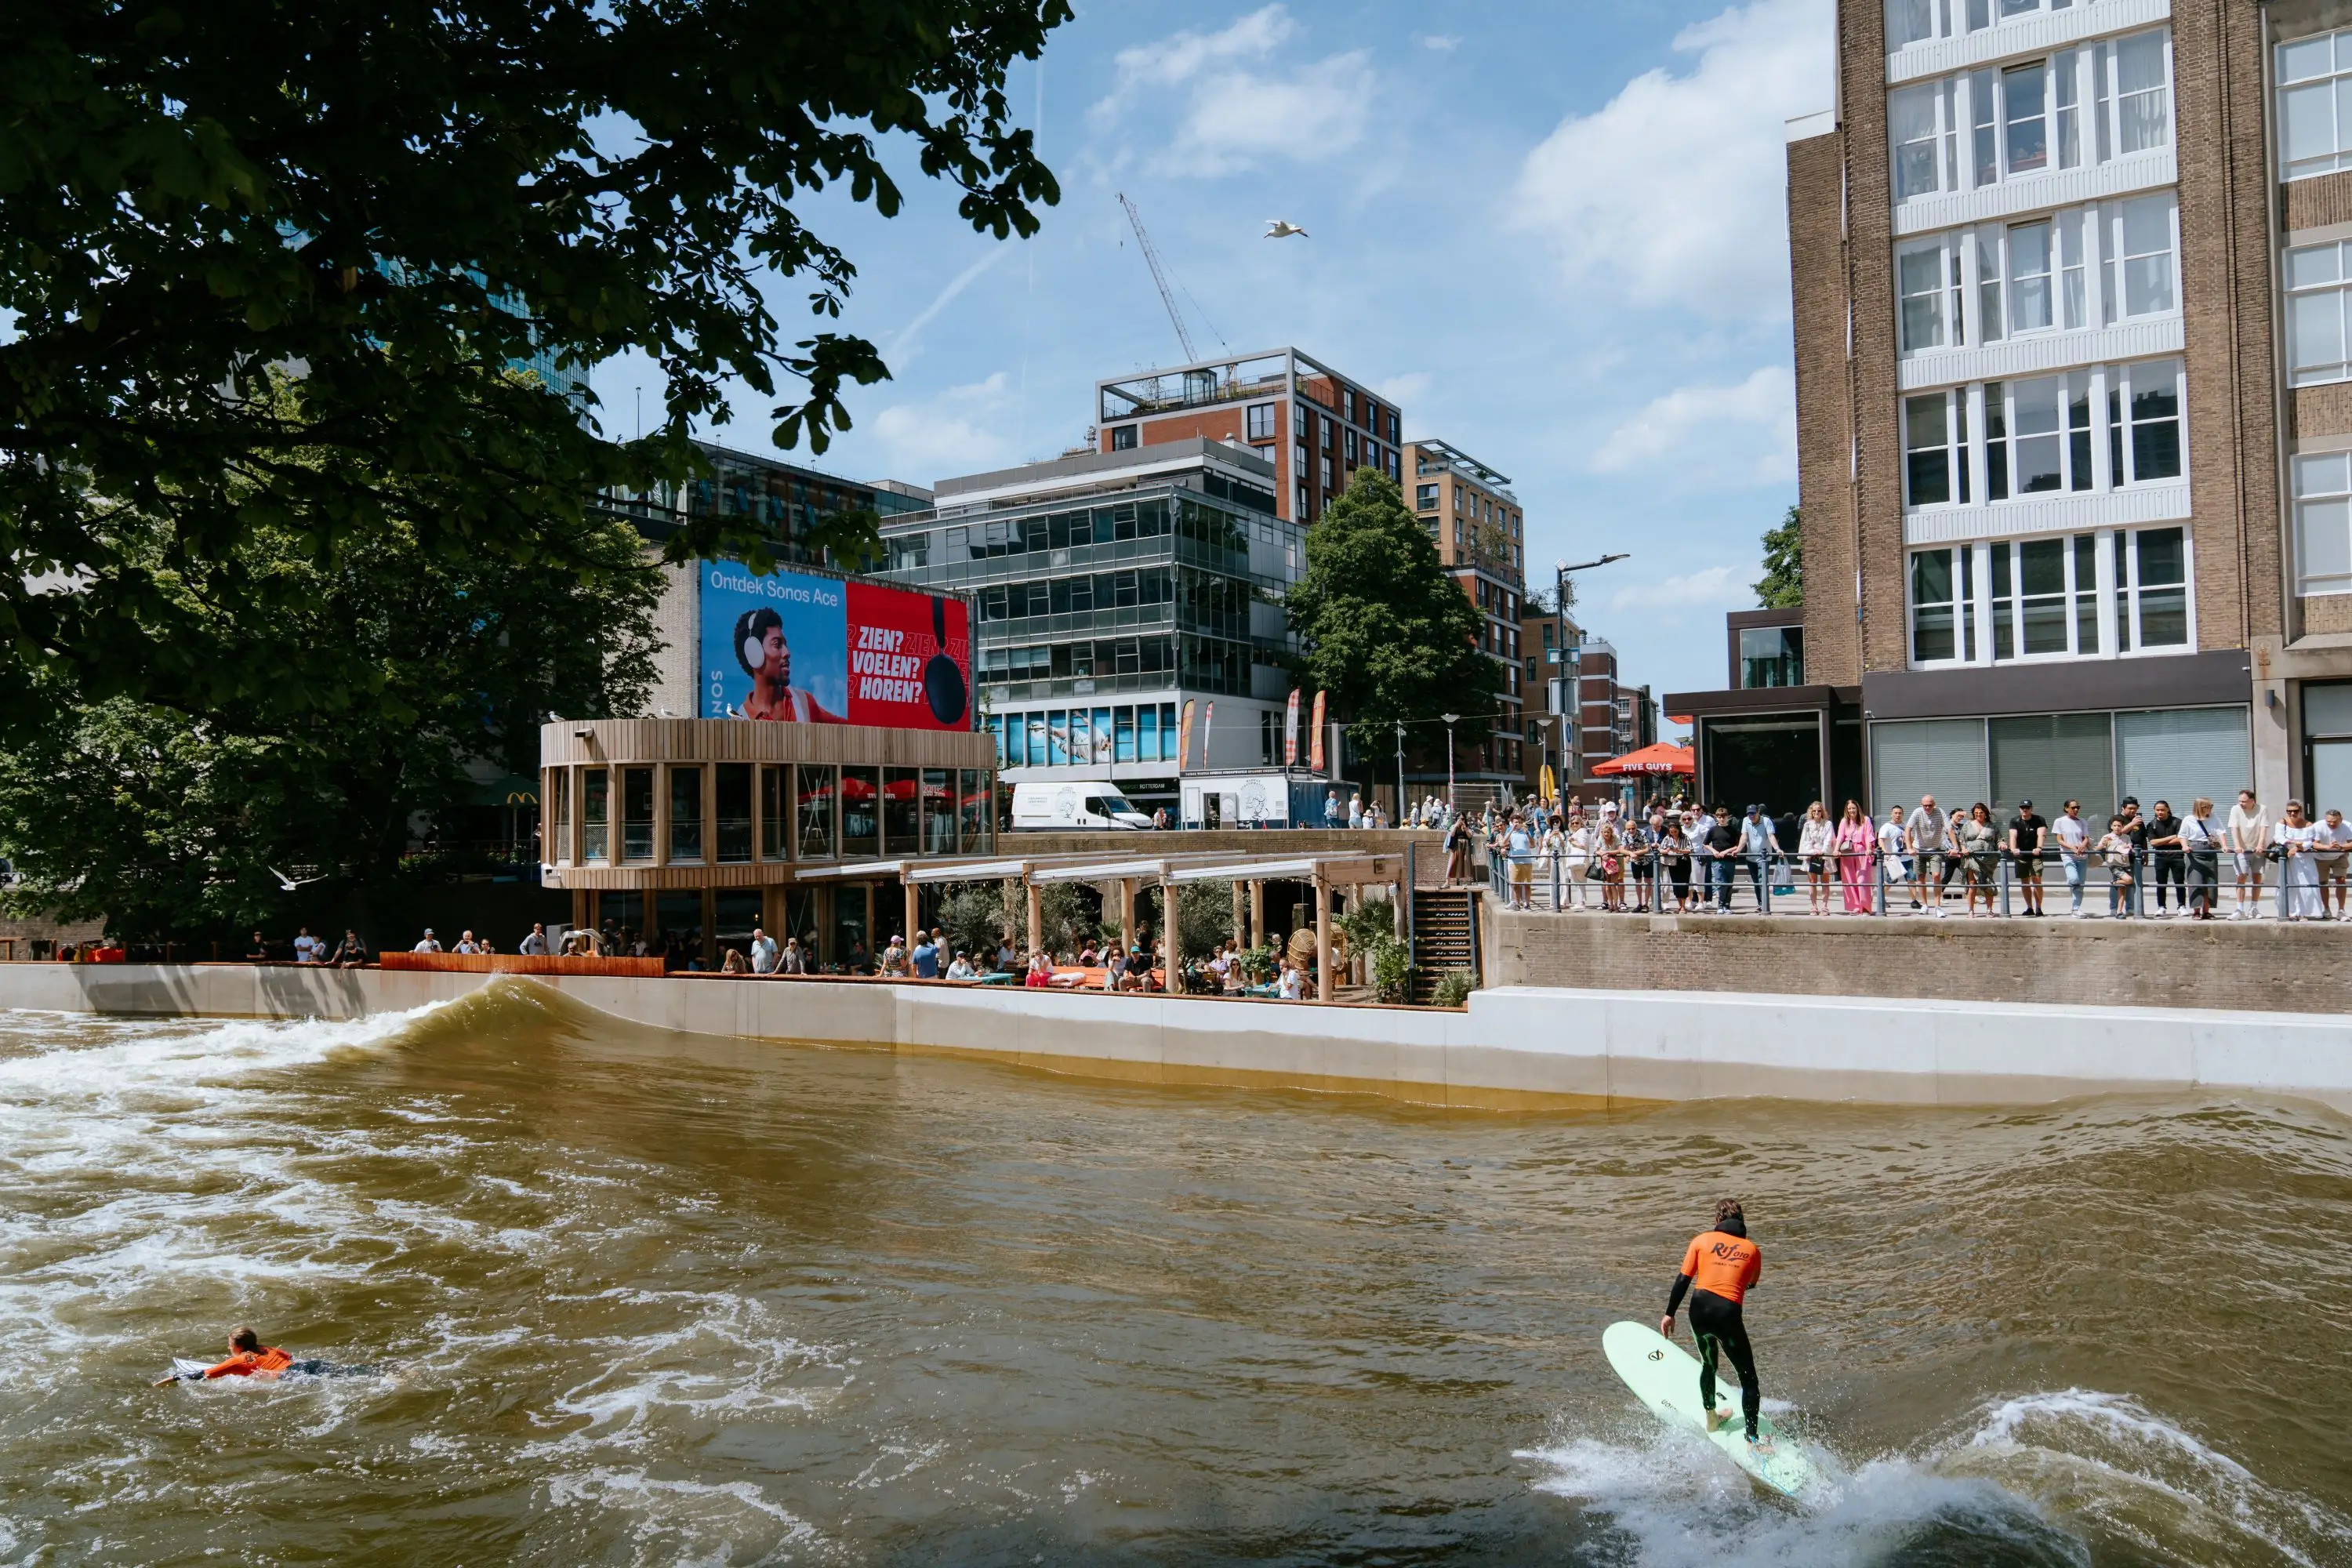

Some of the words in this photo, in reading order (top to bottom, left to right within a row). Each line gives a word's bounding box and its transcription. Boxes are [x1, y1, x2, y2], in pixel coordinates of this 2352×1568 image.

[711, 571, 764, 595] Ontdek
[767, 580, 810, 603] Sonos
[813, 588, 838, 607] Ace
[858, 626, 904, 652] ZIEN?
[852, 650, 920, 679] VOELEN?
[858, 676, 923, 704] HOREN?
[1622, 763, 1644, 771] FIVE
